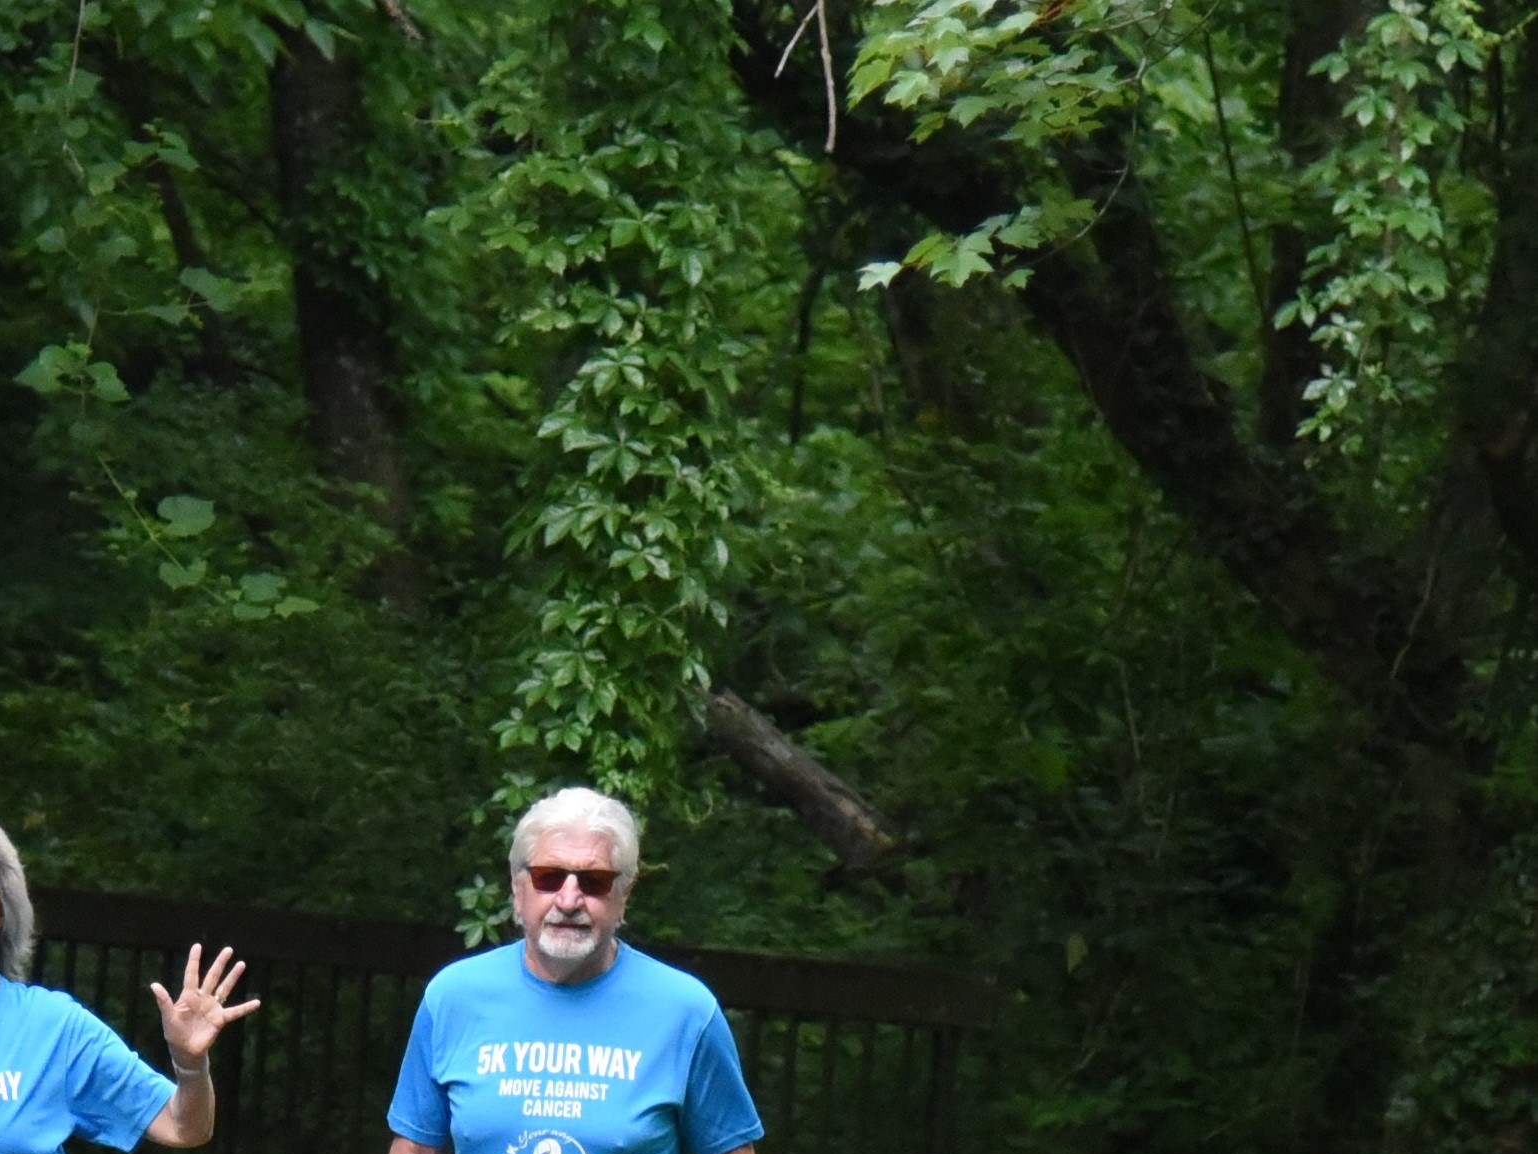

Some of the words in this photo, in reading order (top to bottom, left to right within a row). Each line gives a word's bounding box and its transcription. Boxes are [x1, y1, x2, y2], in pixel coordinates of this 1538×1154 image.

[476, 1043, 508, 1075] 5K
[513, 1042, 581, 1075] YOUR
[587, 1045, 642, 1081] WAY
[499, 1078, 542, 1097] MOVE
[545, 1080, 609, 1101] AGAINST
[522, 1099, 582, 1119] CANCER
